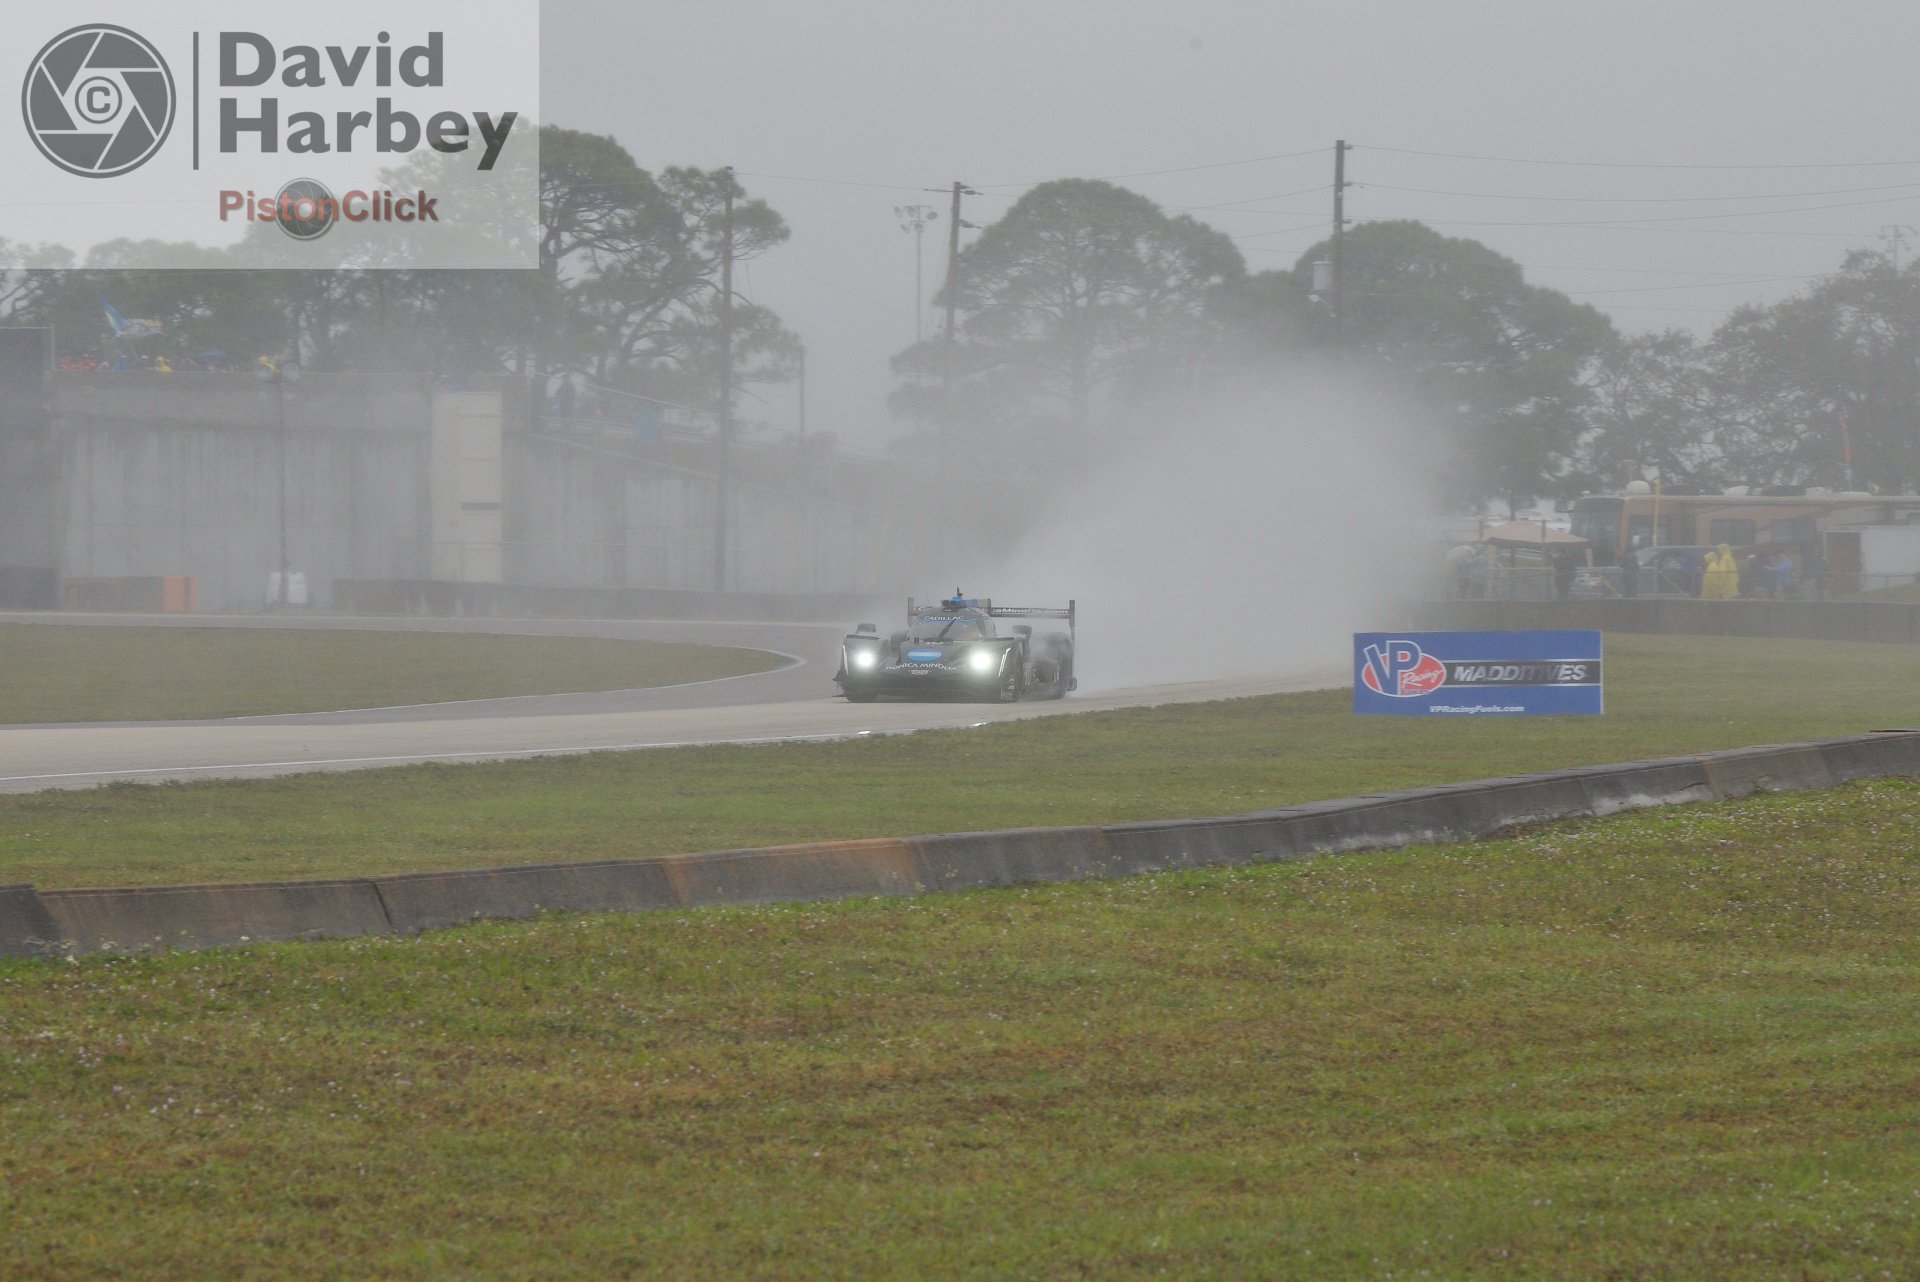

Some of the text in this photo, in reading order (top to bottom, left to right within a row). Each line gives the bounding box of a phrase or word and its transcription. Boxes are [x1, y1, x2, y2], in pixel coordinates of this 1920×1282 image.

[920, 662, 958, 671] MINOLTA
[1363, 640, 1422, 695] VP
[1453, 664, 1588, 682] MADDITIVES
[1402, 670, 1442, 687] Racing
[1429, 704, 1525, 714] VPRacingFuels.com
